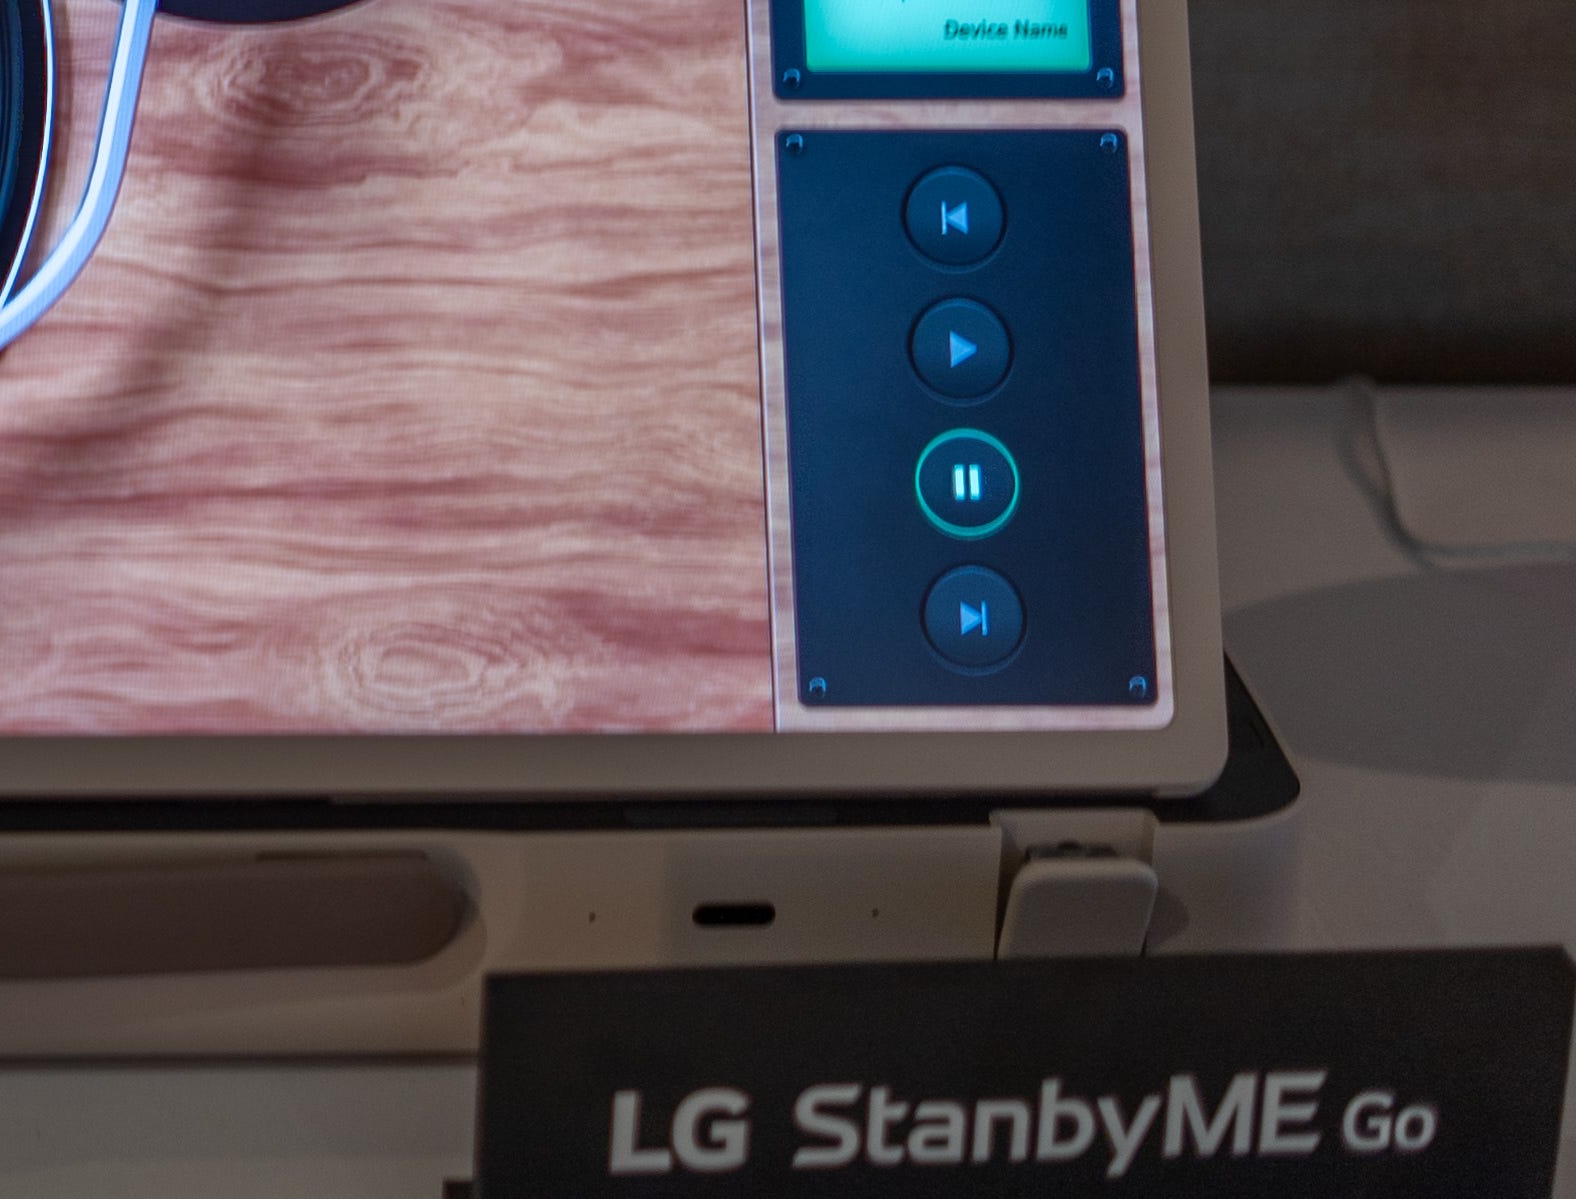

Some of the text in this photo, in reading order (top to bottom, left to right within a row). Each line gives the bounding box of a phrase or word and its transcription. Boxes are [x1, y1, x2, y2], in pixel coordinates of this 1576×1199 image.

[944, 19, 1068, 40] Device Name
[608, 1069, 1437, 1178] LG StanbyME Go
